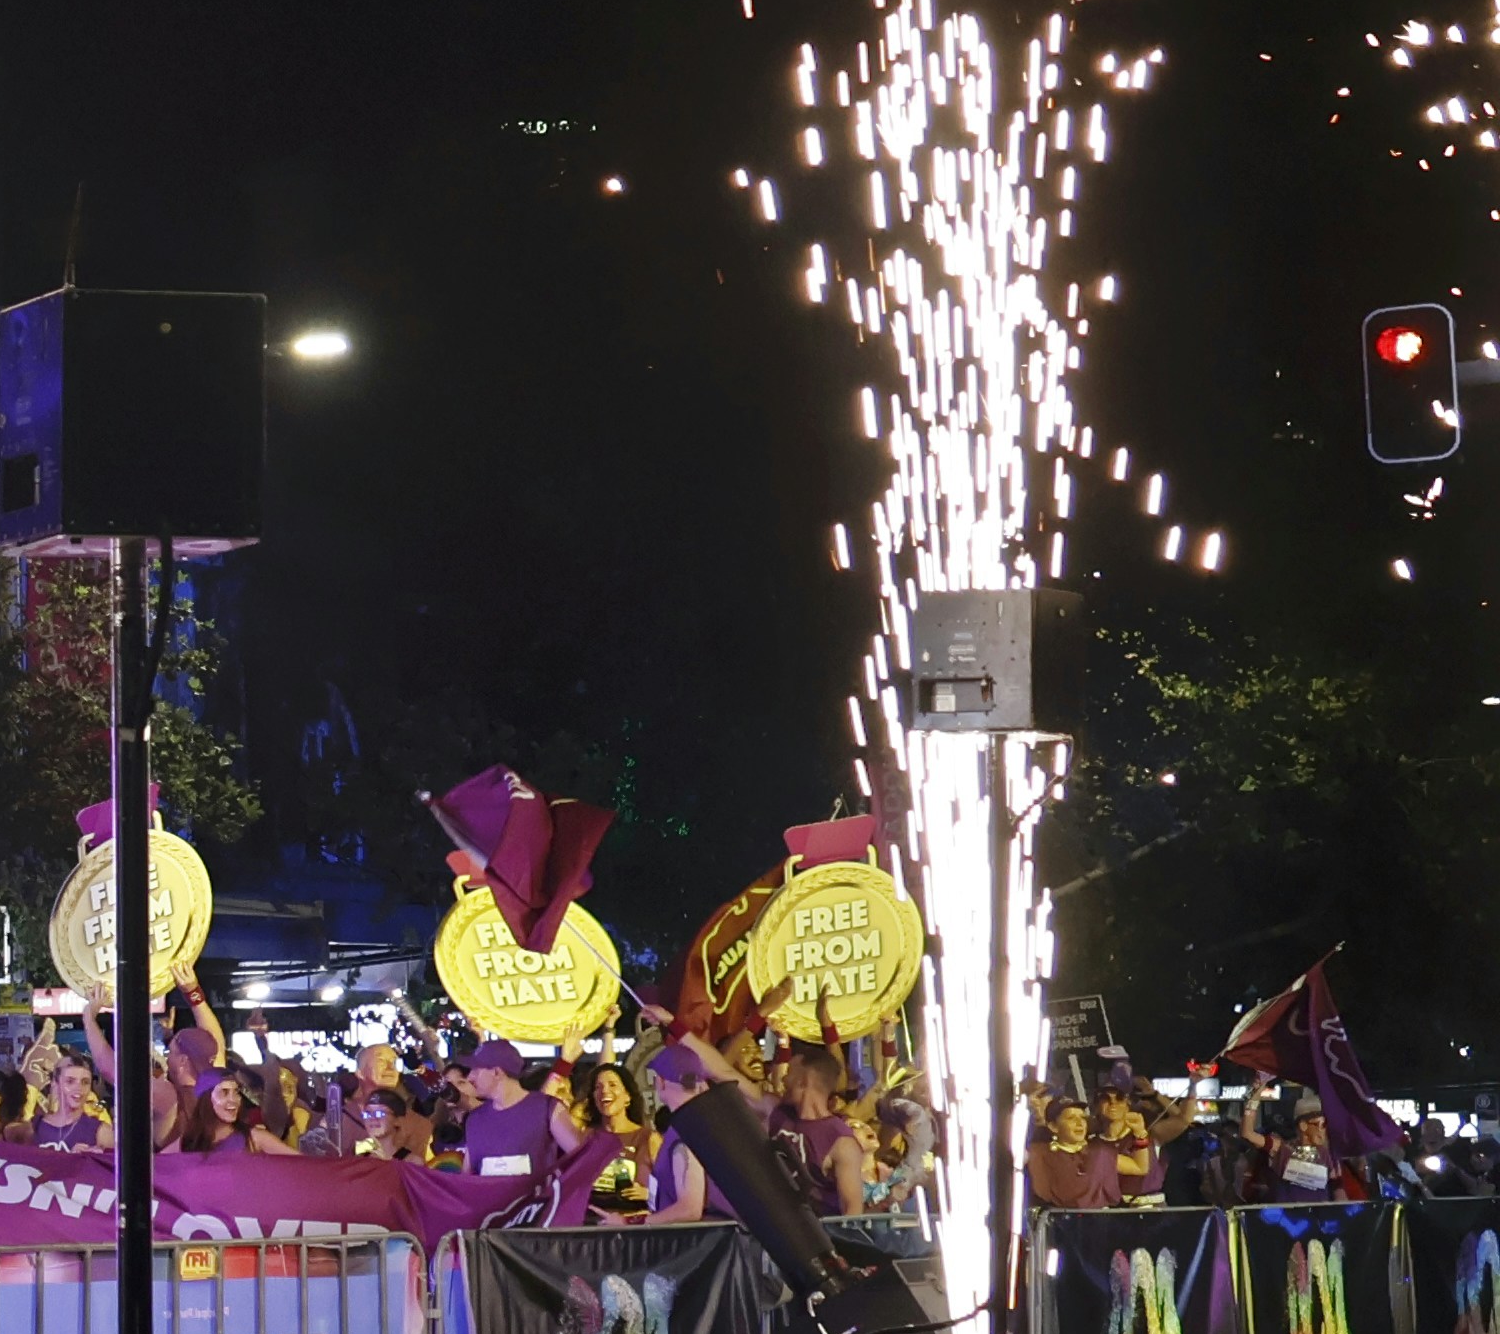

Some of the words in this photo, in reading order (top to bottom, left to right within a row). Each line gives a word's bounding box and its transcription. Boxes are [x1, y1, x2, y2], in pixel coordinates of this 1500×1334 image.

[90, 863, 160, 912] FE
[84, 890, 174, 946] FRM
[474, 922, 517, 948] FR
[795, 899, 869, 937] FREE
[94, 922, 173, 974] HE
[473, 944, 574, 979] FROM
[785, 929, 882, 972] FROM
[489, 974, 578, 1007] HATE
[793, 963, 877, 1004] HATE
